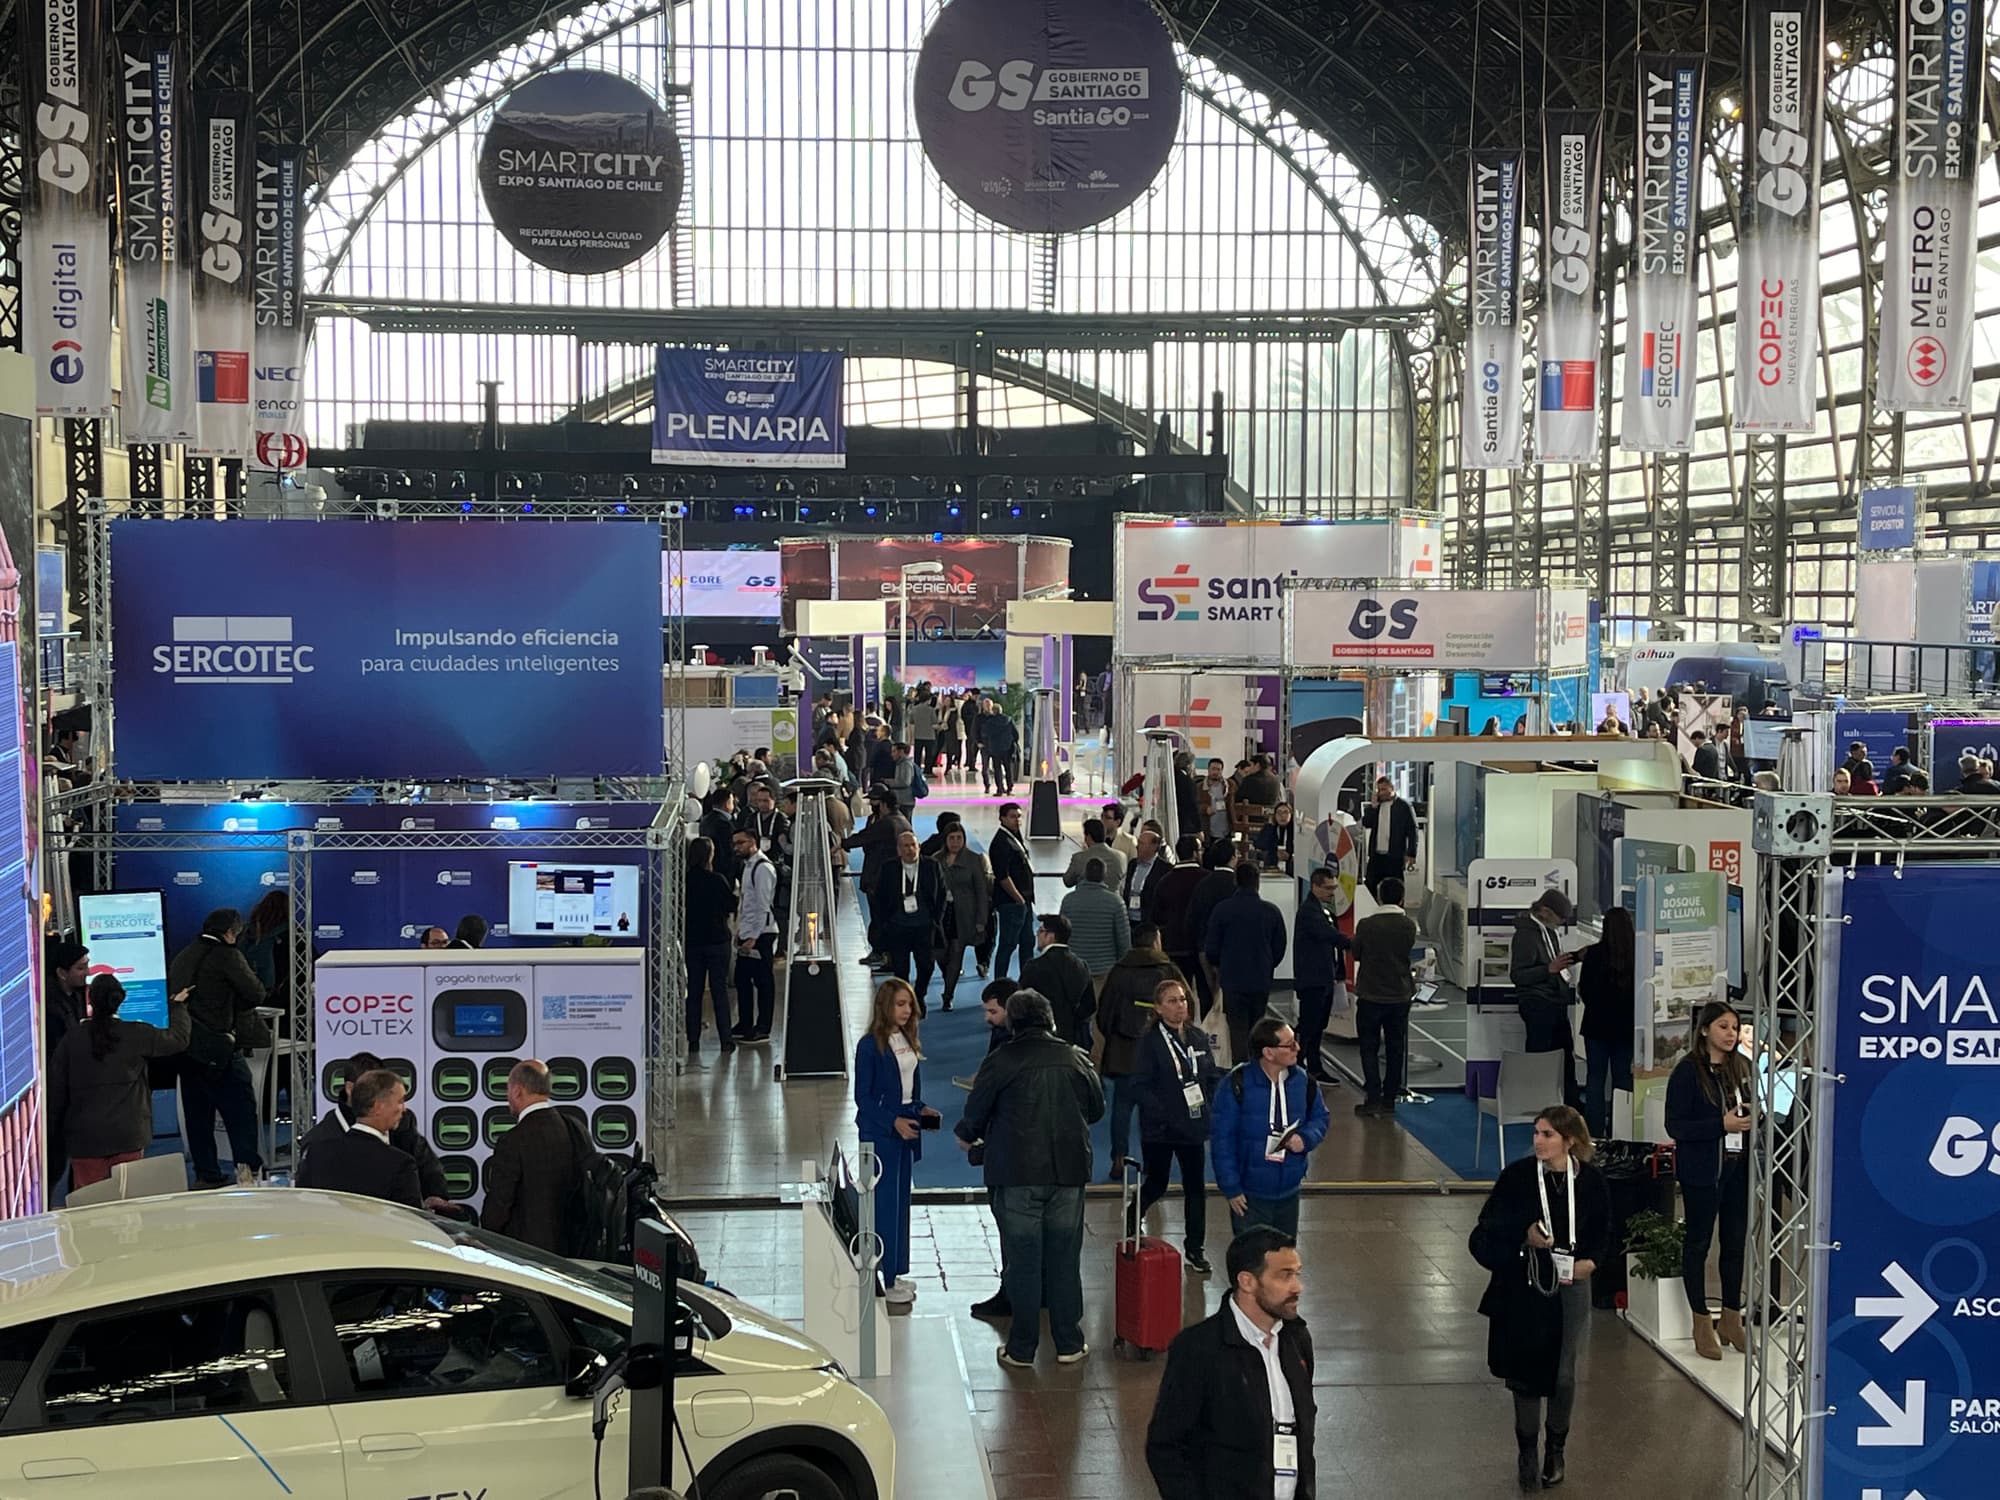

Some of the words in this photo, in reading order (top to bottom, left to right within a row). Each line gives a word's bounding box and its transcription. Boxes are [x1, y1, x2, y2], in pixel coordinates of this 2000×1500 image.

[1774, 20, 1784, 38] DE
[48, 13, 60, 87] GOBIERNO
[1786, 20, 1798, 113] SANTIAGO
[1947, 9, 1966, 116] SANTIAGO
[157, 54, 171, 100] CHILE
[948, 59, 1035, 112] GS
[1048, 72, 1119, 83] GOBIERNO
[1123, 71, 1141, 82] DE
[1049, 84, 1141, 98] SANTIAGO
[1773, 42, 1783, 113] GOBIERNO
[1678, 73, 1691, 118] CHILE
[159, 104, 171, 126] DE
[212, 125, 221, 139] DE
[1033, 106, 1130, 126] SantiaGO
[1677, 121, 1690, 142] DE
[36, 102, 90, 194] GS
[124, 53, 157, 262] SMARTCITY
[222, 126, 233, 200] SANTIAGO
[498, 149, 664, 177] SMARTCITY
[1563, 141, 1572, 155] DE
[1945, 121, 1961, 179] EXPO
[160, 129, 173, 212] SANTIAGO
[212, 143, 221, 200] GOBIERNO
[283, 160, 294, 197] CHILE
[498, 175, 534, 187] EXPO
[537, 177, 604, 190] SANTIAGO
[606, 179, 623, 190] DE
[626, 180, 664, 192] CHILE
[1503, 163, 1513, 199] CHILE
[1563, 158, 1572, 214] GOBIERNO
[1573, 141, 1583, 214] SANTIAGO
[1641, 71, 1673, 274] SMARTCITY
[1674, 145, 1688, 227] SANTIAGO
[1757, 127, 1808, 216] GS
[283, 200, 294, 218] DE
[1502, 201, 1512, 219] DE
[161, 216, 175, 260] EXPO
[201, 211, 243, 283] GS
[256, 160, 278, 326] SMARTCITY
[519, 227, 590, 239] RECUPERANDO
[592, 230, 604, 239] LA
[606, 231, 643, 241] CIUDAD
[531, 237, 558, 247] PARA
[559, 238, 578, 247] LAS
[579, 239, 631, 249] PERSONAS
[1475, 162, 1498, 326] SMARTCITY
[283, 221, 294, 287] SANTIAGO
[1502, 221, 1512, 287] SANTIAGO
[1551, 225, 1590, 294] GS
[1672, 231, 1686, 274] EXPO
[1910, 206, 1934, 327] METRO
[1937, 208, 1950, 300] SANTIAGO
[52, 244, 83, 329] digital
[283, 290, 293, 326] EXPO
[1501, 290, 1511, 326] EXPO
[1936, 305, 1947, 328] DE
[145, 297, 156, 374] MUTUAL
[1758, 279, 1784, 386] COPEC
[704, 358, 794, 373] SMARTCITY
[1656, 320, 1674, 409] SERCOTEC
[1787, 340, 1797, 385] NUEVAS
[725, 390, 747, 405] GS
[1483, 362, 1499, 453] SantiaGO
[667, 413, 830, 442] PLENARIA
[1870, 518, 1905, 531] EXPOSITOR
[690, 575, 721, 584] CORE
[745, 575, 776, 587] GS
[1208, 606, 1273, 621] SMART
[1348, 598, 1419, 640] GS
[395, 628, 517, 651] Impulsando
[521, 628, 619, 647] eficiencia
[1335, 647, 1376, 655] GOBIERNO
[1377, 647, 1389, 655] DE
[1390, 647, 1432, 655] SANTIAGO
[152, 645, 314, 673] SERCOTEC
[361, 657, 409, 676] para
[410, 654, 499, 673] ciudades
[504, 653, 619, 676] inteligentes
[1712, 848, 1723, 868] DE
[1485, 876, 1507, 889] GS
[1660, 909, 1673, 920] DE
[1674, 906, 1706, 919] LLUVIA
[1663, 896, 1701, 909] BOSQUE
[88, 920, 101, 929] EN
[104, 918, 156, 929] SERCOTEC
[477, 972, 521, 984] network
[325, 995, 414, 1014] COPEC
[326, 1018, 414, 1037] VOLTEX
[1859, 1036, 1943, 1059] EXPO
